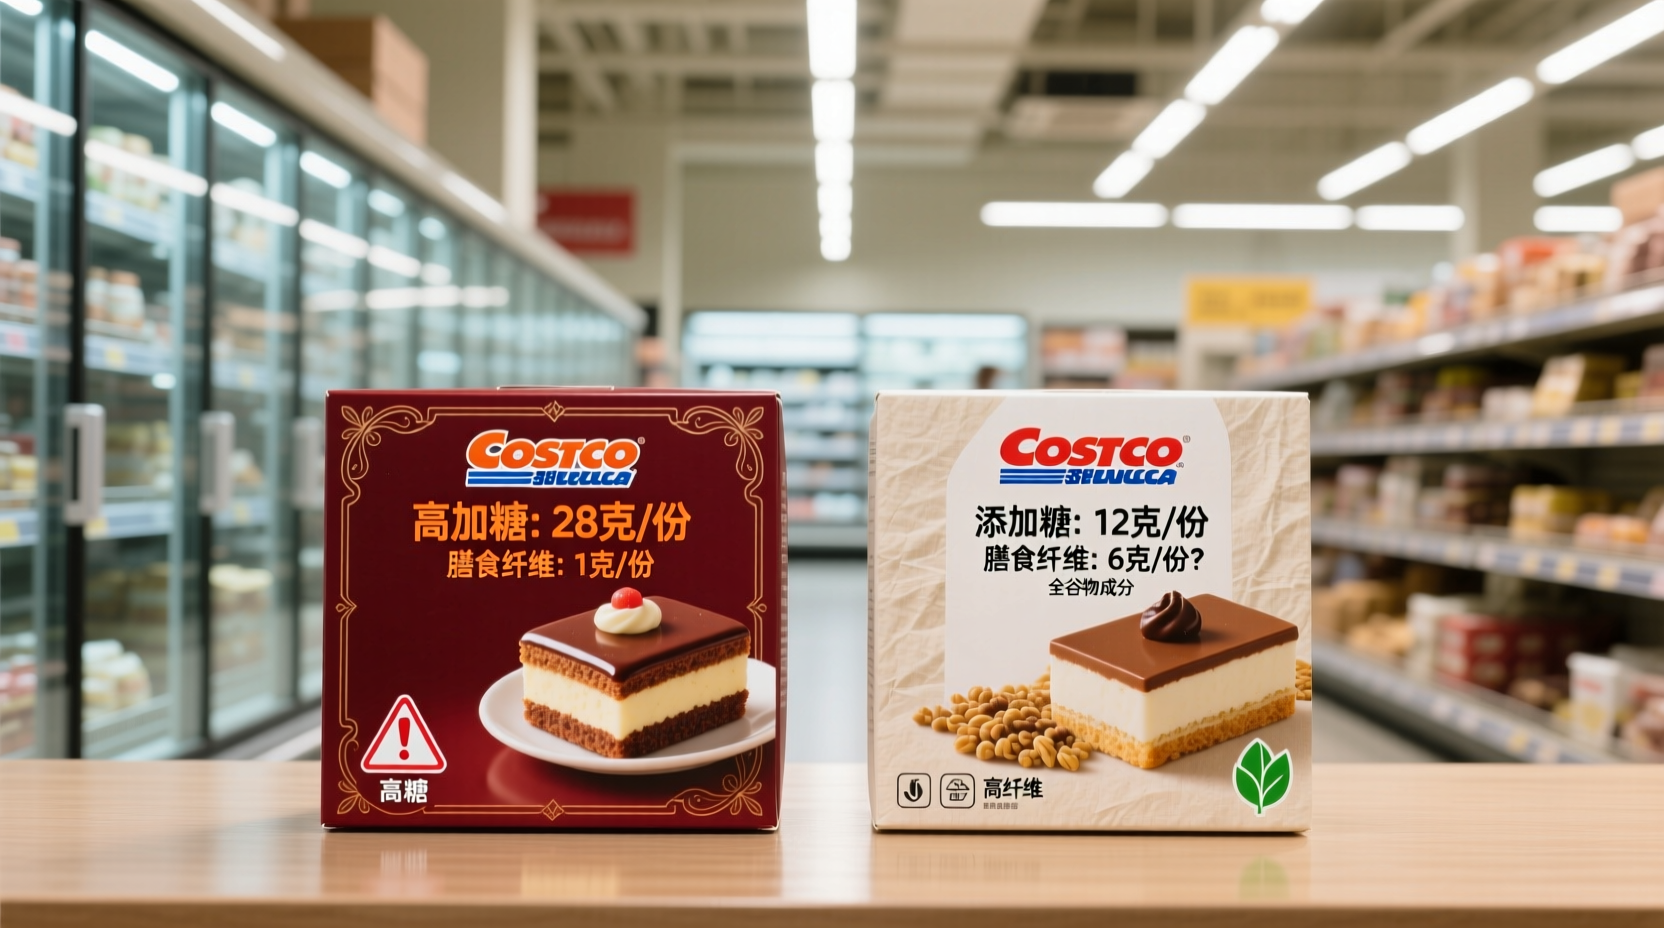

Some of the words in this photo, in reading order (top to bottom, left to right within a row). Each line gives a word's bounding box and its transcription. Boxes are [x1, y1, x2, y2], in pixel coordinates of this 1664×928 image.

[466, 430, 640, 470] COSTCO
[1000, 427, 1183, 467] COSTCO
[1048, 577, 1135, 597] 全谷物成分
[379, 778, 428, 804] 高糖
[983, 776, 1044, 800] 高纤维
